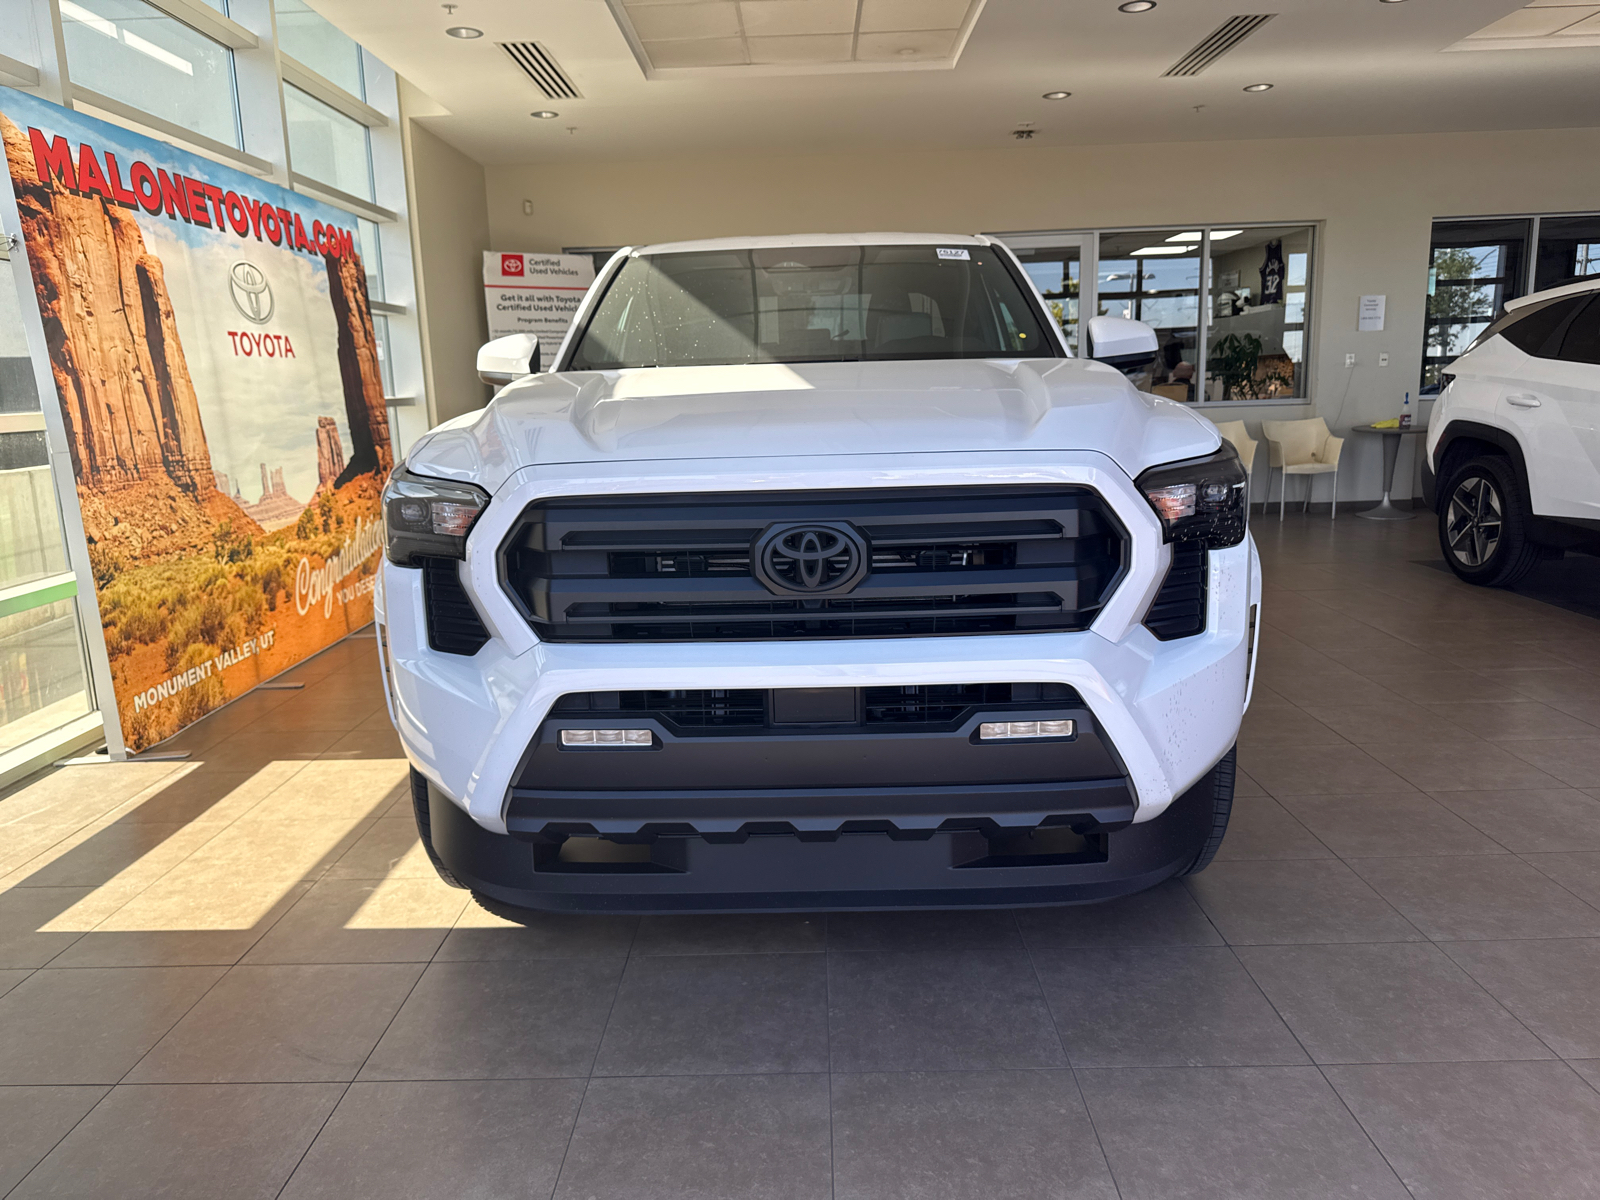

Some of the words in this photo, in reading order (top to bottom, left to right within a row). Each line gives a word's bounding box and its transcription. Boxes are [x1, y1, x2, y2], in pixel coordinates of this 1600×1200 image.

[27, 126, 356, 261] MALONETOYOTA.COM
[529, 258, 560, 267] Certified
[549, 268, 579, 276] Vehicles
[1264, 275, 1280, 295] 32
[500, 294, 515, 302] Get
[516, 294, 524, 302] it
[524, 294, 535, 302] all
[536, 295, 554, 303] with
[555, 296, 581, 304] Toyota
[496, 304, 532, 312] Certified
[517, 317, 543, 325] Program
[227, 331, 296, 359] TOYOTA
[336, 587, 355, 606] YOU
[133, 660, 213, 713] MONUMENT
[214, 638, 261, 672] VALLEY,
[259, 630, 275, 652] UT
